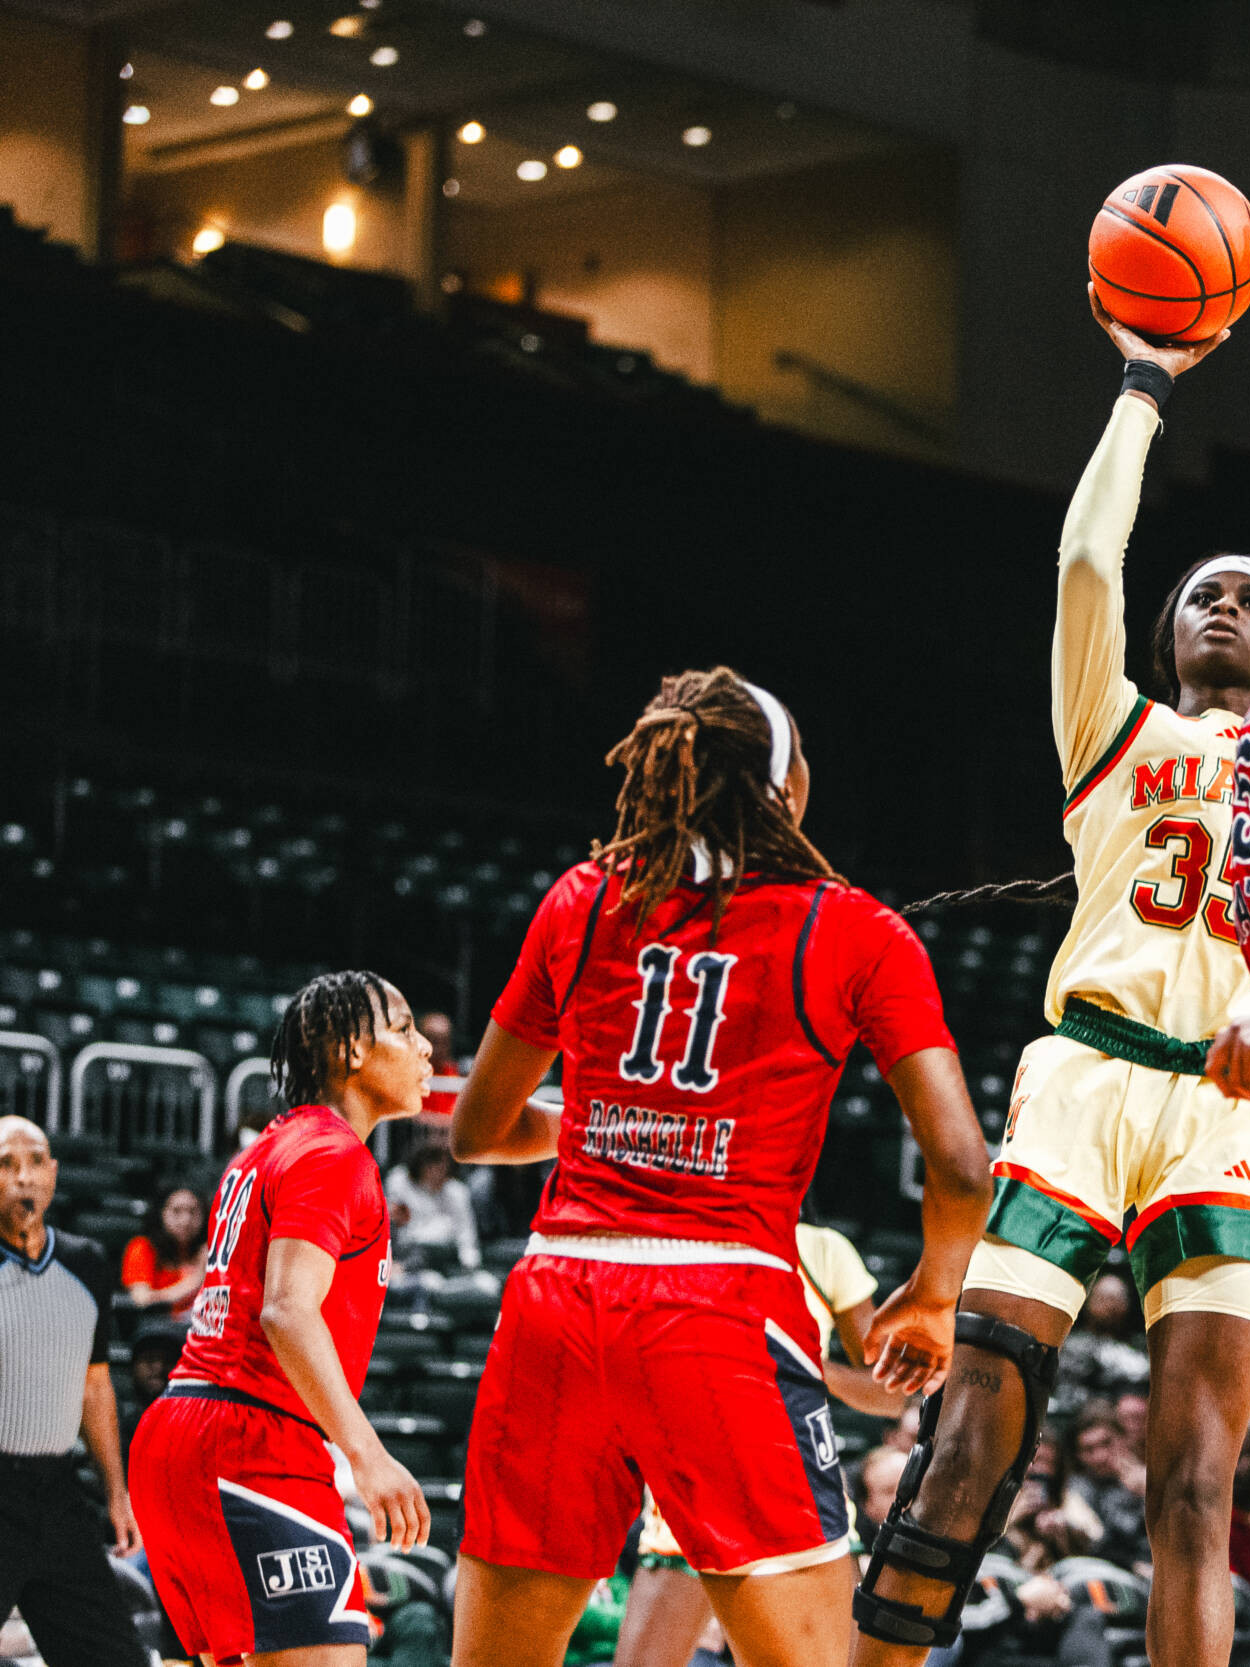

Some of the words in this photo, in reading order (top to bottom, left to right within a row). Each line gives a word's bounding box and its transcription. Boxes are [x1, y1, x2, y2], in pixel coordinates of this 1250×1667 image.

[1130, 815, 1239, 945] 35
[620, 943, 738, 1094] 11
[206, 1168, 257, 1273] 10
